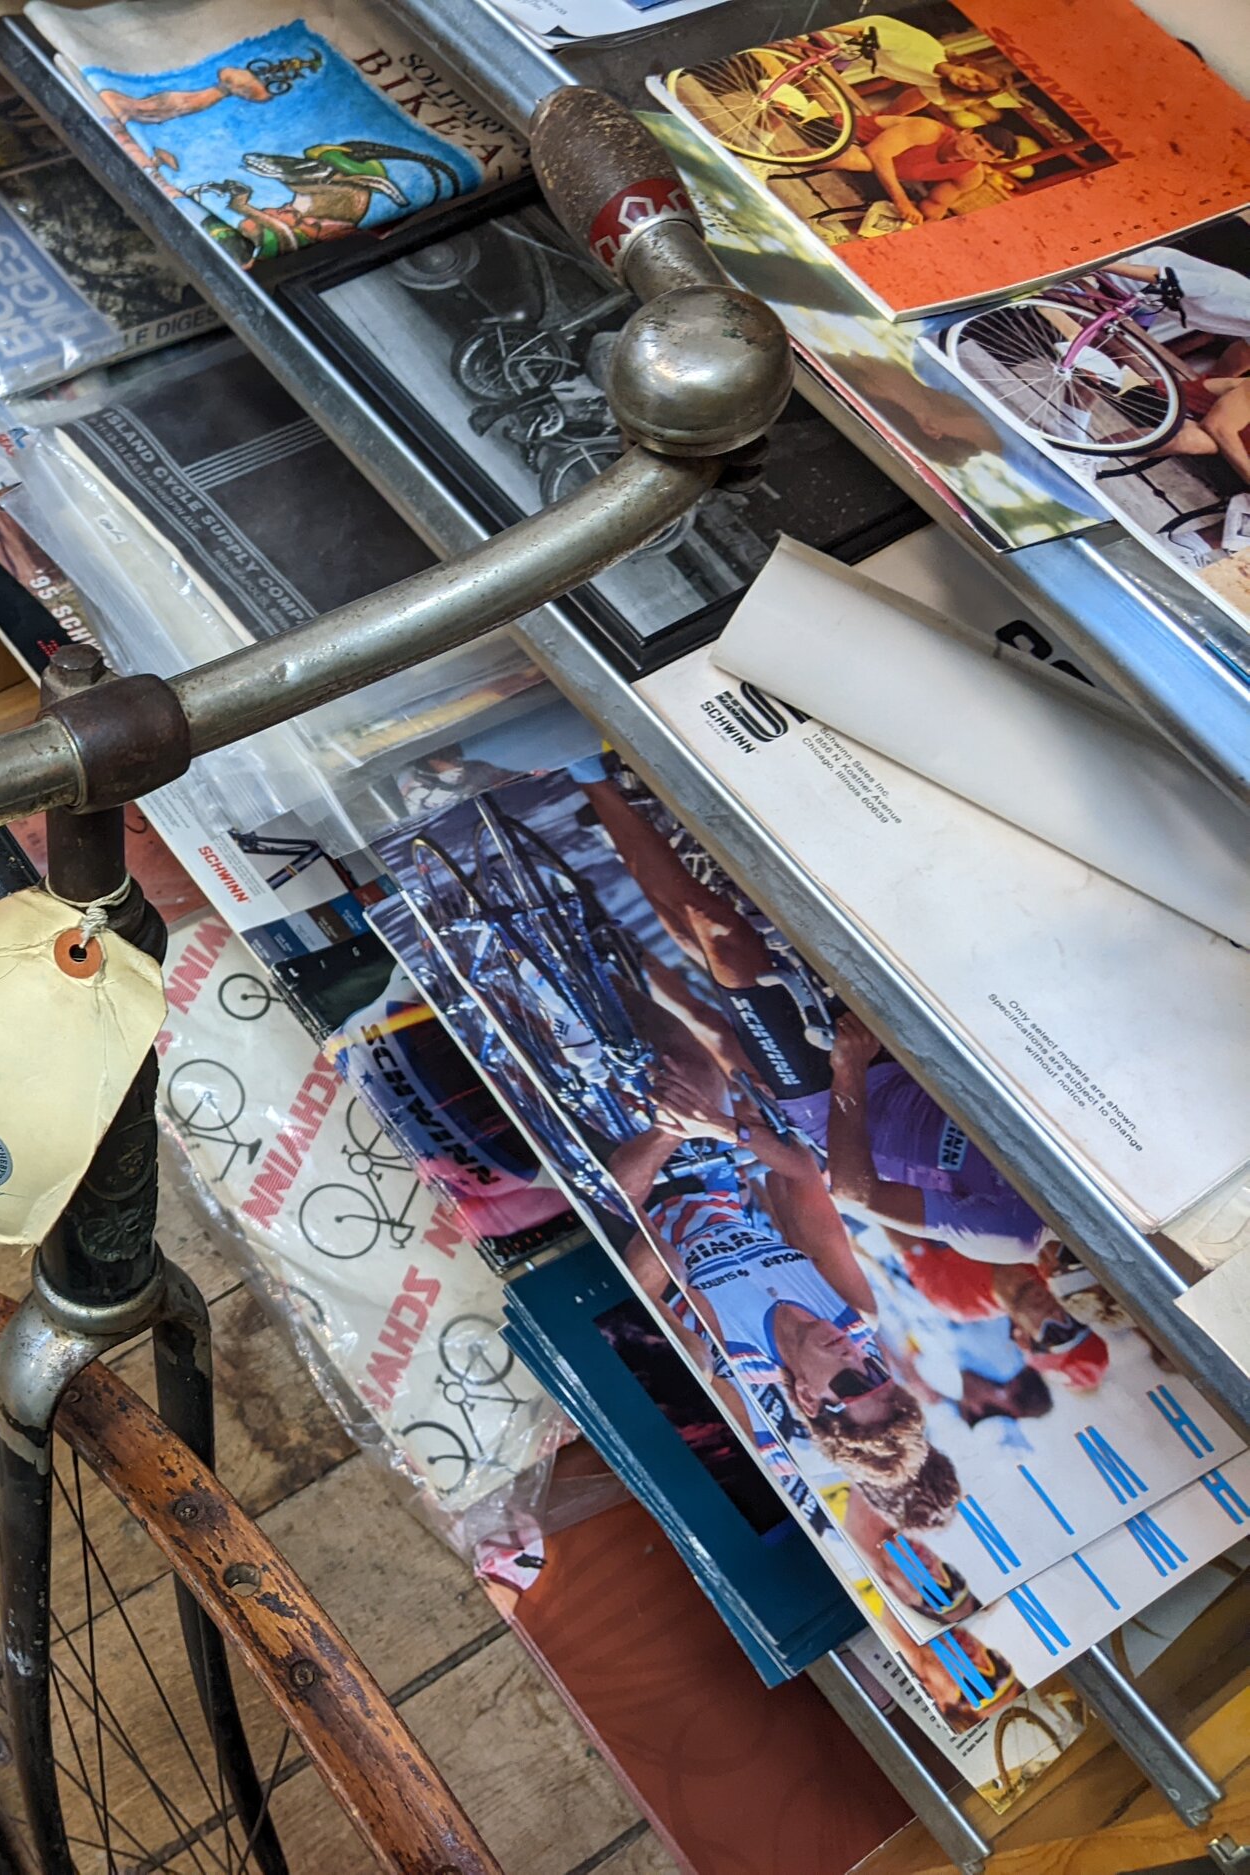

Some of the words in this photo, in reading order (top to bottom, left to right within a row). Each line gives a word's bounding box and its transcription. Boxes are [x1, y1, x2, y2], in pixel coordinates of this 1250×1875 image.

[984, 25, 1137, 161] SCHWINN
[155, 309, 219, 340] DIGES
[102, 411, 155, 463] ISLAND
[153, 465, 203, 513] CYCLE
[201, 515, 260, 572] SUPPLY
[700, 700, 756, 754] SCHWINN
[819, 727, 853, 761] Schwinn
[852, 760, 876, 784] Sales
[876, 783, 890, 799] Inc.
[802, 737, 834, 772] Chicago,
[835, 771, 861, 798] Illinois
[860, 796, 889, 824] 60639
[842, 763, 872, 795] Kostner
[872, 794, 902, 824] Avenue
[198, 845, 250, 903] SCHWINN
[164, 915, 234, 1015] WINN
[730, 996, 801, 1086] SCHWINN
[988, 993, 1048, 1055] Specifications
[1048, 1055, 1064, 1071] are
[1064, 1072, 1099, 1106] subject
[1098, 1105, 1109, 1117] to
[1109, 1117, 1143, 1152] change
[1009, 1000, 1030, 1022] Only
[1030, 1023, 1058, 1050] select
[1057, 1050, 1090, 1083] models
[1090, 1083, 1106, 1100] are
[1106, 1100, 1138, 1133] shown.
[1024, 1045, 1058, 1079] without
[1057, 1078, 1087, 1110] notice.
[360, 1024, 502, 1187] SCHWINN
